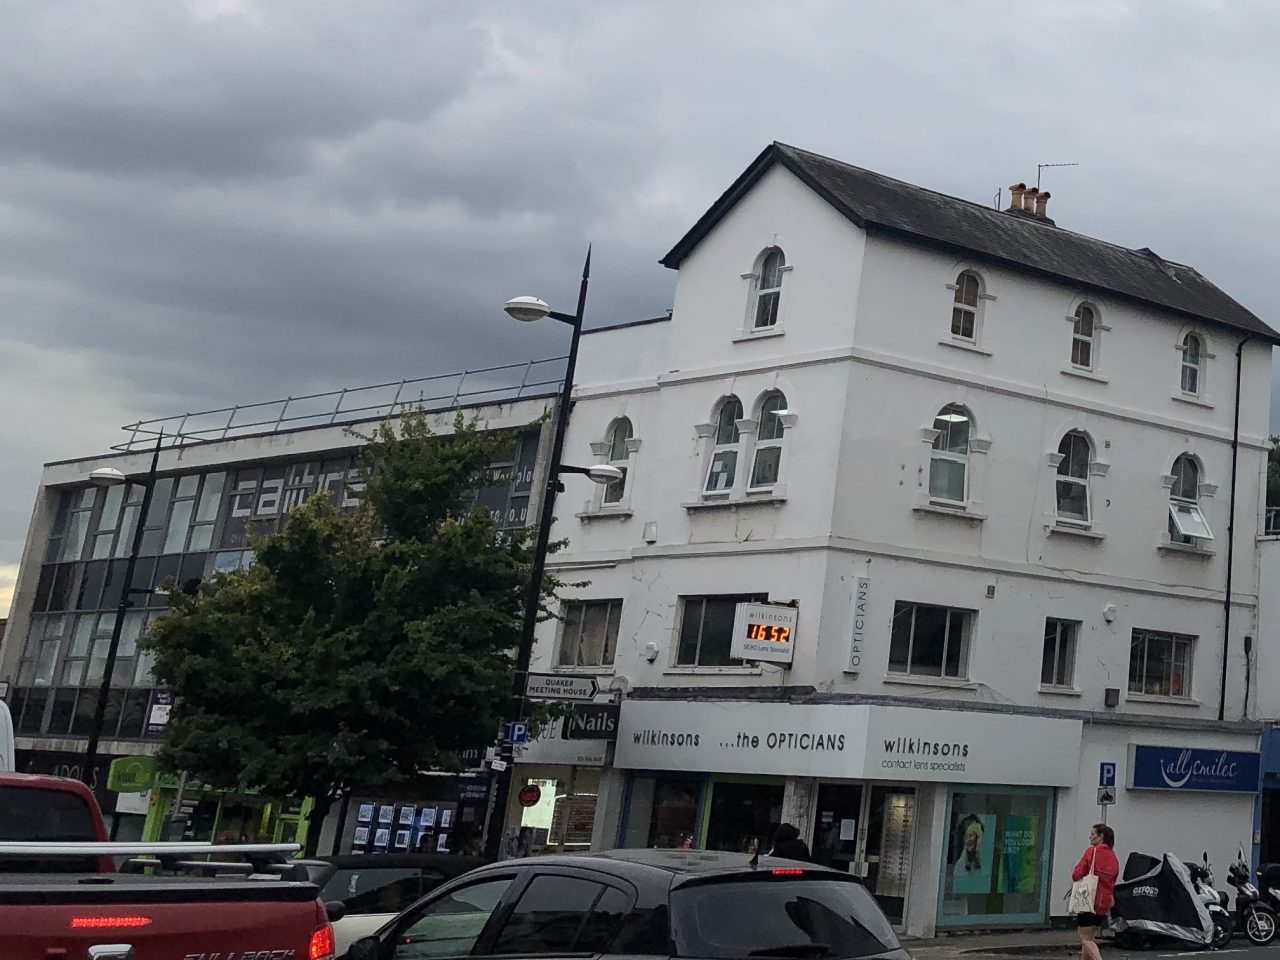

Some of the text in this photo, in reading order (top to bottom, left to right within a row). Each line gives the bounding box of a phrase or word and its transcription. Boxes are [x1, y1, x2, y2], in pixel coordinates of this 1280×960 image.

[749, 612, 793, 623] wilkinsons
[851, 581, 868, 667] OPTICIANS
[529, 686, 588, 696] MEETING HOUSE
[545, 678, 574, 687] QUAKER
[573, 712, 616, 731] Nails
[513, 724, 525, 741] P
[632, 729, 700, 747] wilkinsons
[766, 732, 846, 751] OPTICIANS
[883, 737, 969, 757] wilkinsons
[881, 760, 966, 772] contact lens specialists
[1192, 751, 1239, 778] smiles
[1102, 764, 1114, 785] P
[1132, 885, 1159, 896] OXFORD
